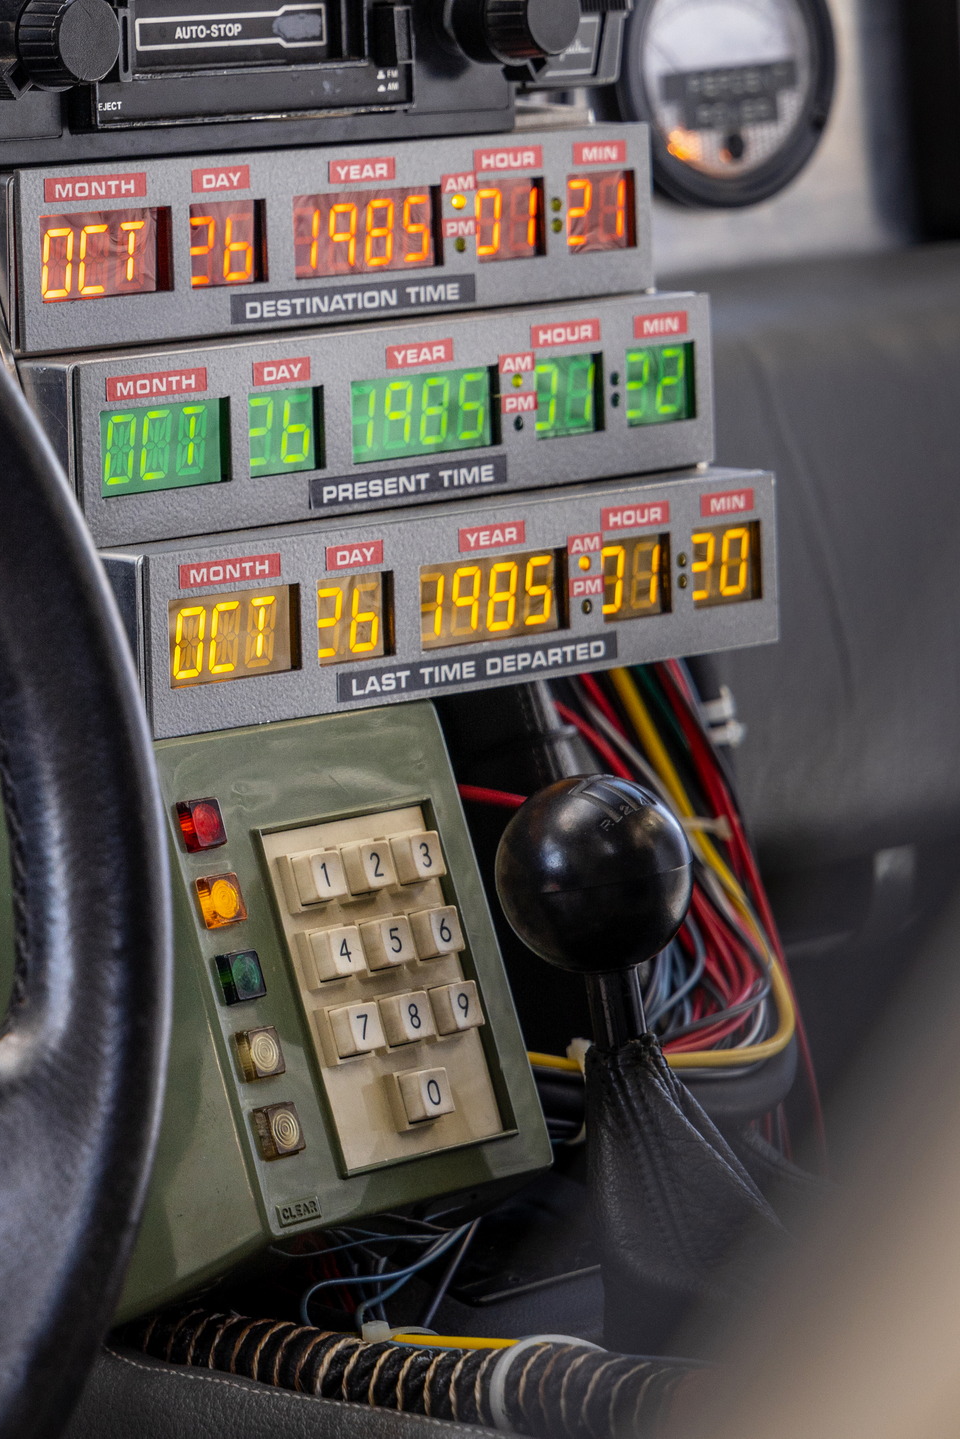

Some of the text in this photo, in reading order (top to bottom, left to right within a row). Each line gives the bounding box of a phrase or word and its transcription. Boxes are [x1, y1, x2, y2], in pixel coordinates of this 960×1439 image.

[175, 23, 242, 39] AUTO-STOP
[386, 70, 399, 78] FM
[387, 81, 399, 91] AM
[98, 101, 122, 111] EJECT
[55, 146, 618, 198] MONTH DAY YEAR HOUR MIN
[445, 175, 475, 192] AM
[41, 221, 145, 298] OCT
[310, 195, 429, 270] 1985
[475, 186, 538, 256] 01
[567, 179, 626, 246] 21
[446, 221, 475, 236] PM
[245, 283, 460, 319] DESTINATION TIME
[117, 317, 679, 396] MONTH DAY YEAR HOUR MIN
[503, 357, 532, 372] AM
[505, 396, 534, 411] PM
[105, 405, 207, 485] OCT
[366, 372, 485, 448] 1985
[323, 464, 494, 503] PRESENT TIME
[190, 494, 745, 583] MONTH DAY YEAR HOUR MIN
[571, 537, 600, 553] AM
[573, 578, 602, 595] PM
[173, 595, 276, 680] OCT
[434, 555, 552, 636] 1985
[352, 641, 605, 696] LAST TIME DEPARTED
[320, 842, 432, 887] 1 2 3
[339, 918, 452, 963] 4 5 6
[355, 993, 469, 1040] 7 8 9
[427, 1079, 440, 1106] 0
[280, 1199, 319, 1222] CLEAR
